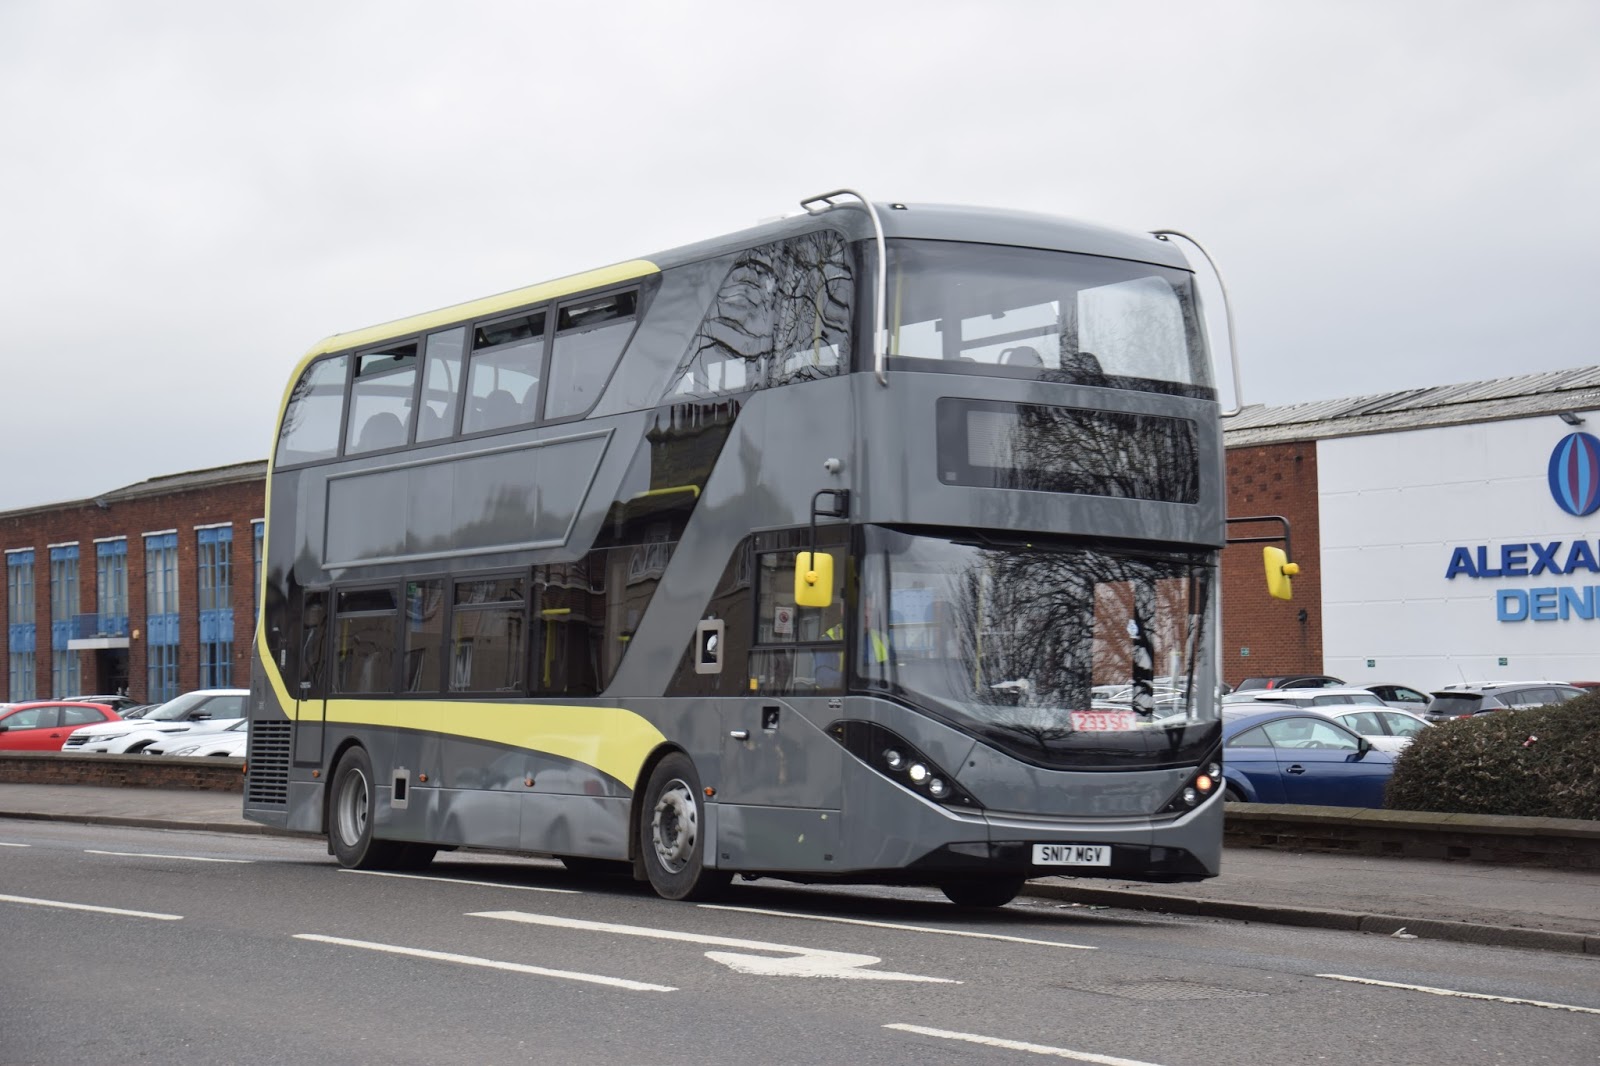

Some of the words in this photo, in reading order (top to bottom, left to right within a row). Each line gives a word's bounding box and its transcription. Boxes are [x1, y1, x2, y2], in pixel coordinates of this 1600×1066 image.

[1445, 540, 1600, 579] ALEXA
[1496, 586, 1600, 622] DEN
[1078, 714, 1107, 730] 233
[1042, 846, 1072, 862] SN17
[1076, 848, 1103, 862] MGV
